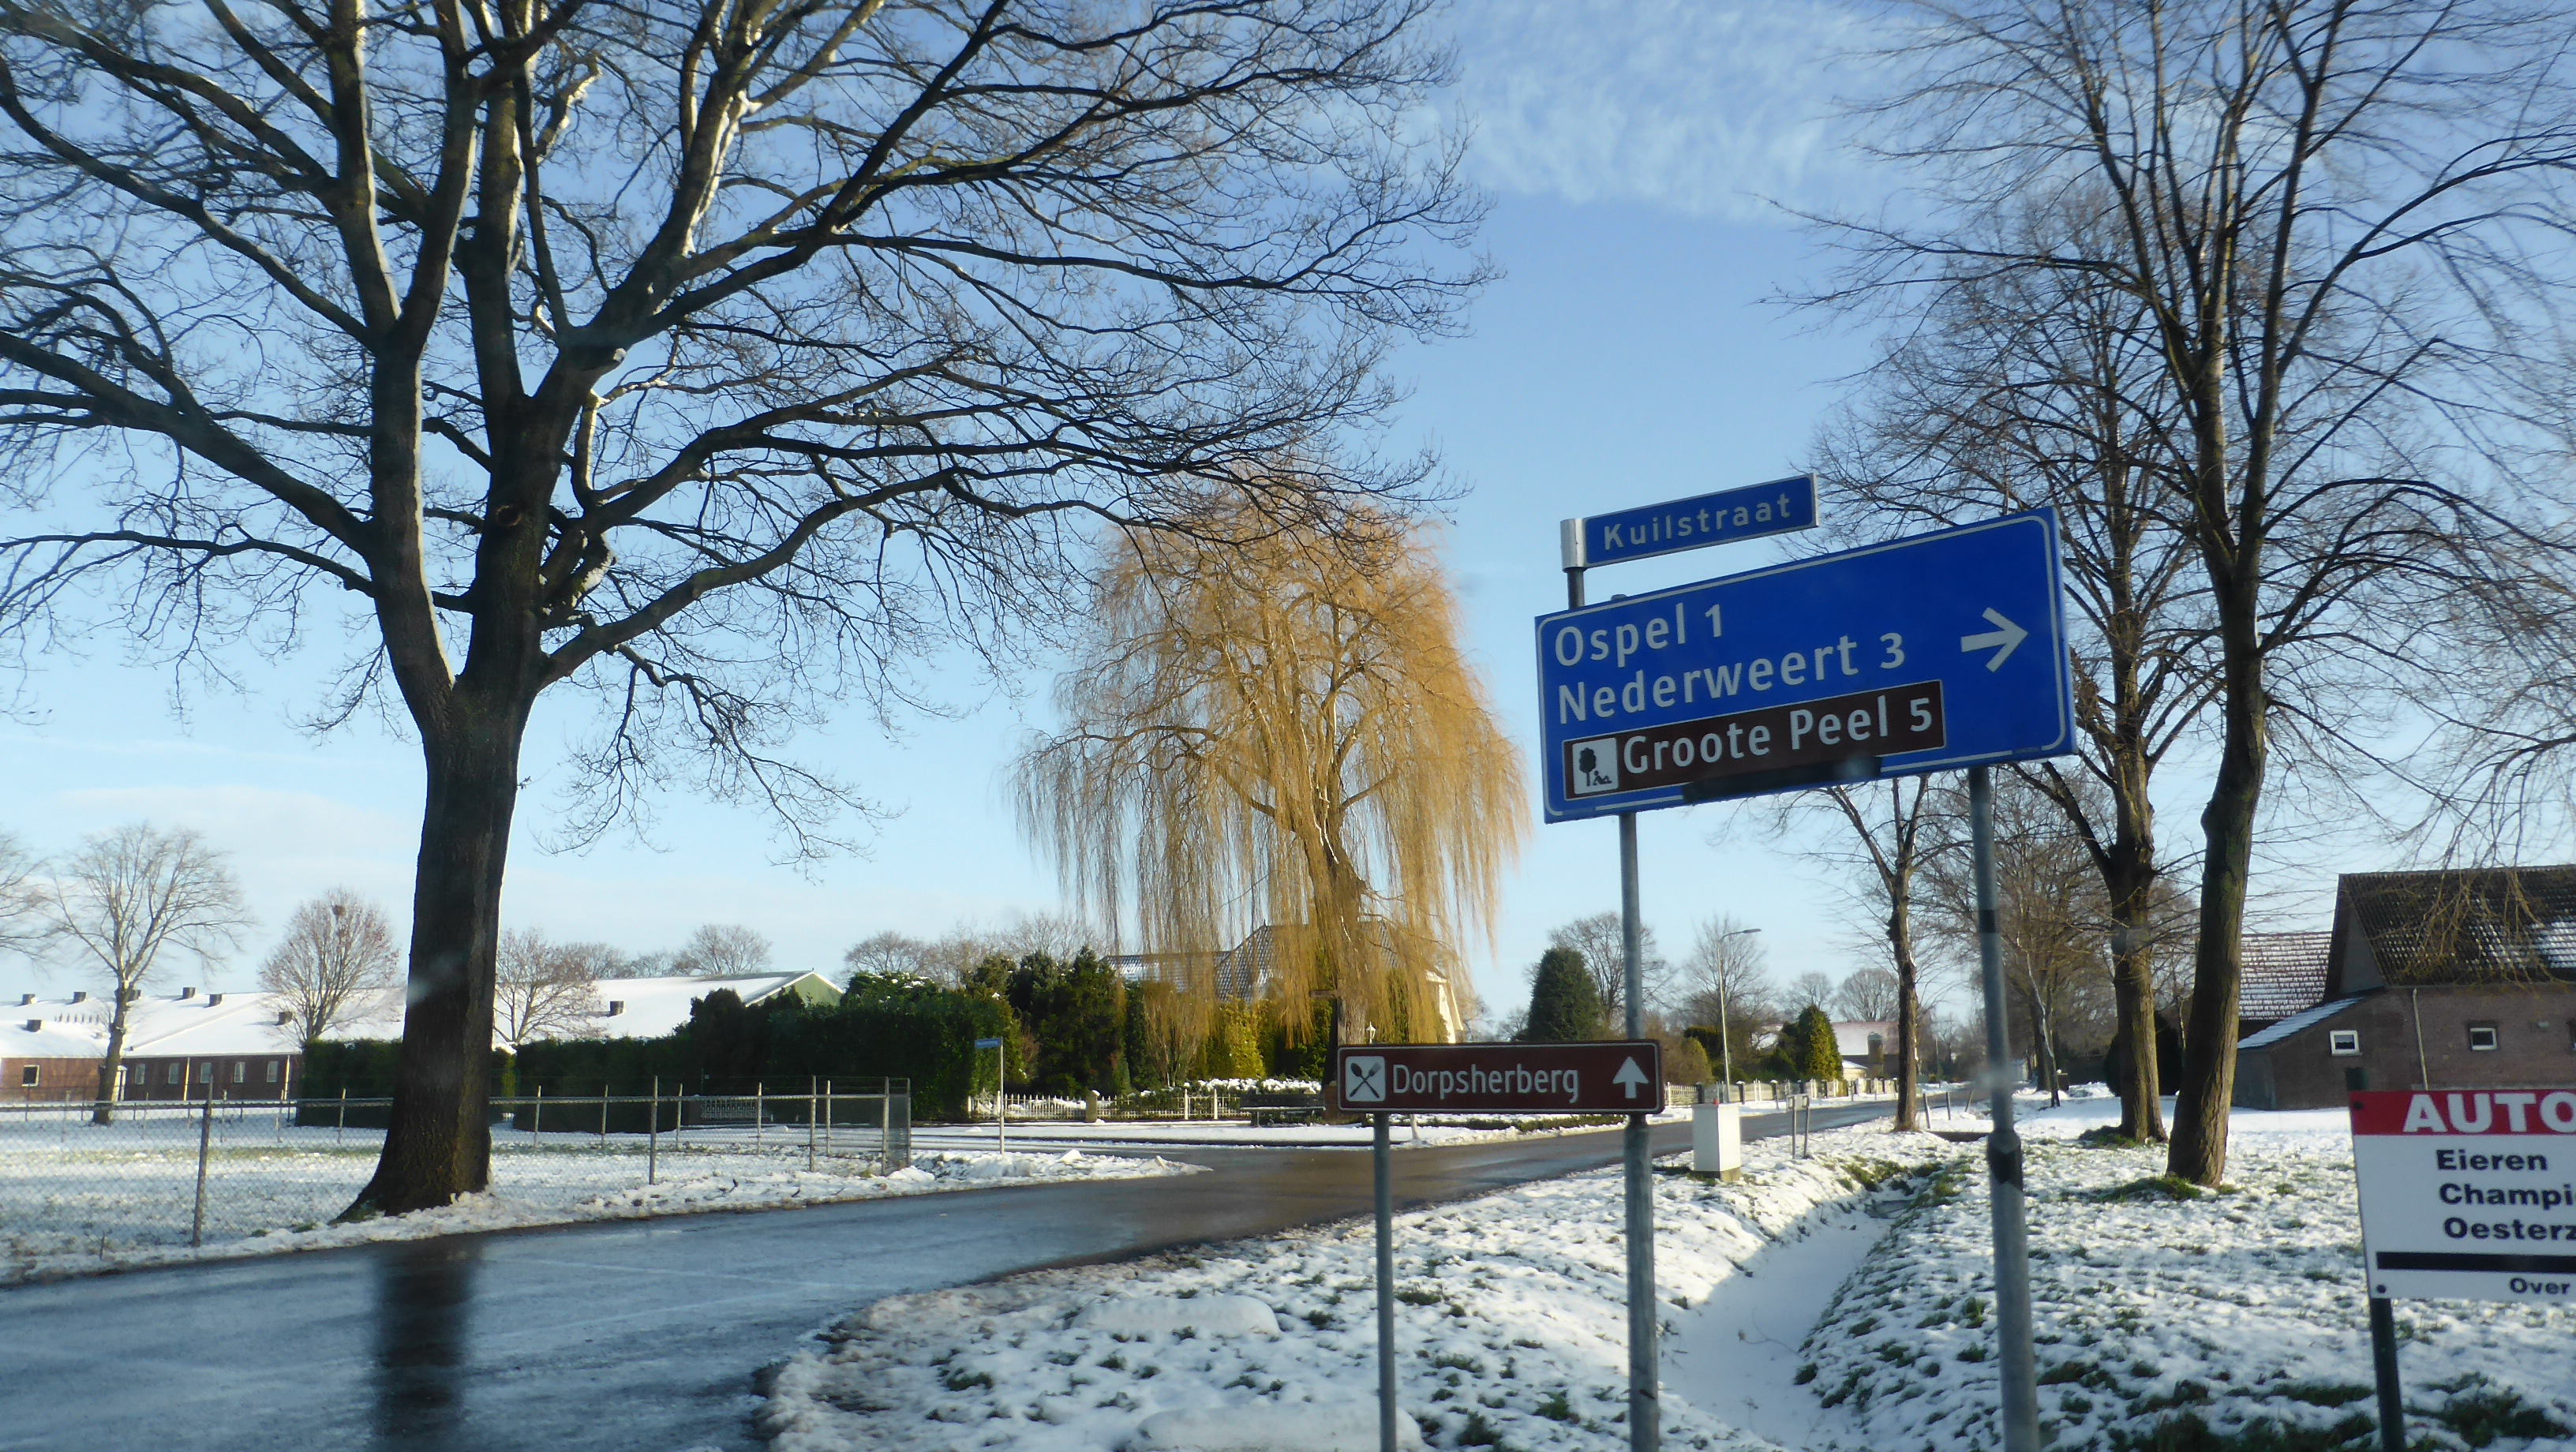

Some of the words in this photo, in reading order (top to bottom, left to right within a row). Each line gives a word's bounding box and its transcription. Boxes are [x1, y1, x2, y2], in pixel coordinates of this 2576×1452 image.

[1604, 492, 1791, 550] Kuilstraat
[1555, 603, 1687, 668] Ospel
[1704, 604, 1724, 638] 1
[1559, 635, 1859, 725] Nederweert
[1880, 633, 1906, 670] 3
[1623, 723, 1771, 775] Groote
[1790, 696, 1888, 750] Peel
[1910, 698, 1933, 732] 5
[1393, 1063, 1578, 1103] Dorpsherberg
[2403, 1091, 2576, 1133] AUTO
[2436, 1149, 2548, 1170] Eieren
[2439, 1183, 2576, 1210] Champi
[2443, 1217, 2576, 1241] Oesterz
[2509, 1278, 2570, 1295] Over
